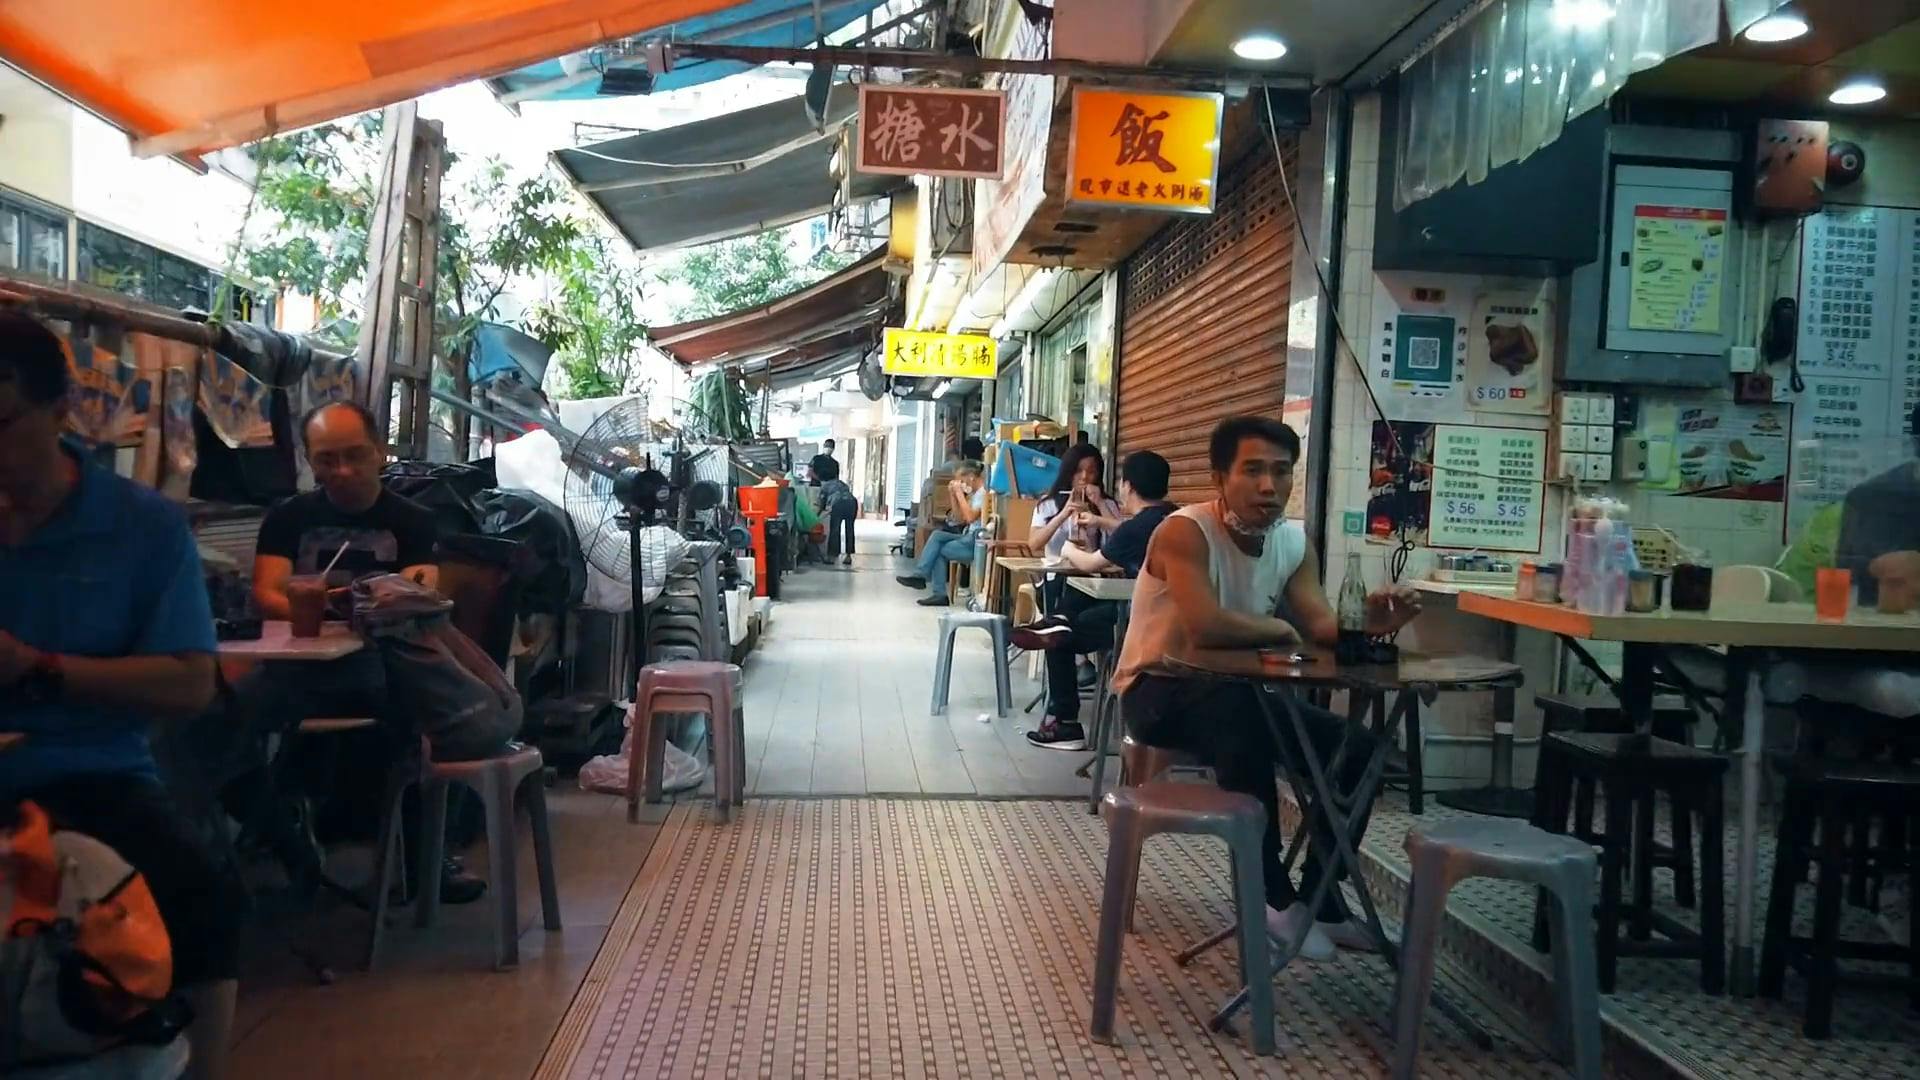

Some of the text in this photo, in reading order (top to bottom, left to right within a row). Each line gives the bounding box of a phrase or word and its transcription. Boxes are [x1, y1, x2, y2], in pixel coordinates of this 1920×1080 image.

[868, 95, 995, 167] 糖水
[1110, 103, 1178, 174] 飯
[1489, 387, 1506, 400] 60
[1459, 502, 1476, 515] 56
[1510, 505, 1527, 518] 45
